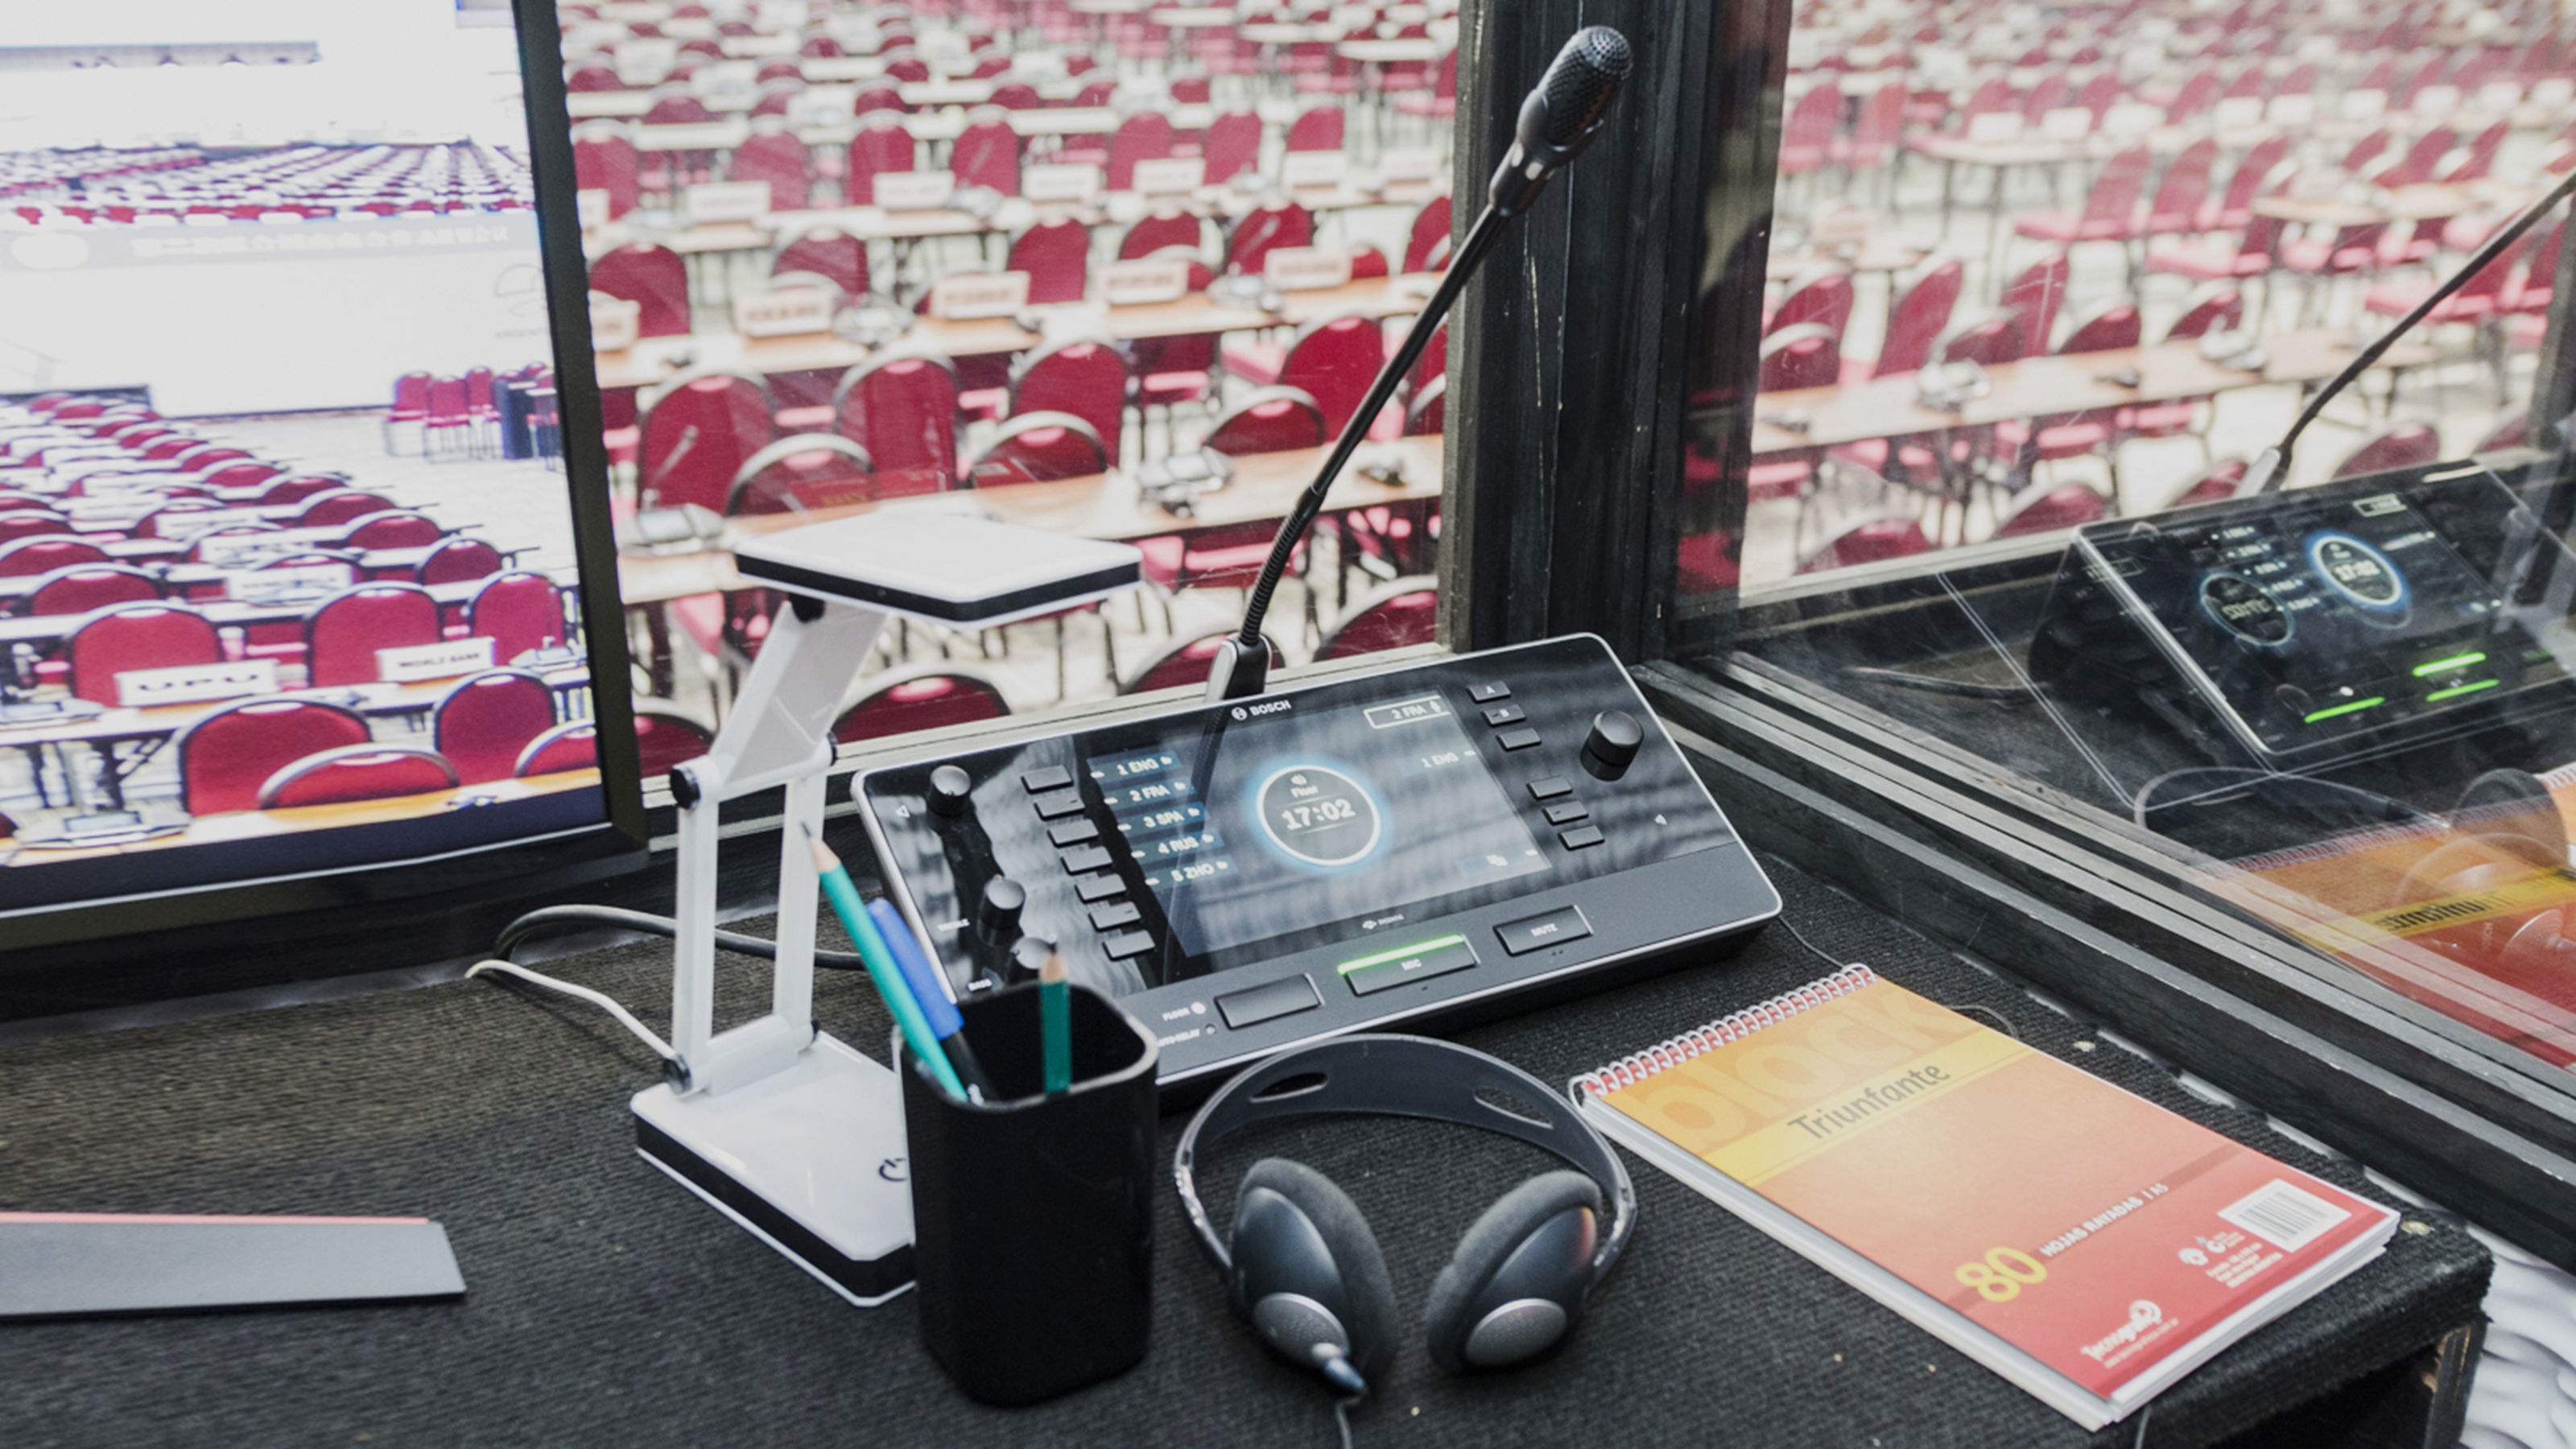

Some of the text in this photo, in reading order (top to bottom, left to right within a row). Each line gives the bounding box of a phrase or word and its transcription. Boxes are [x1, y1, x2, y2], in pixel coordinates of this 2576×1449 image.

[1486, 685, 1496, 695] A
[1249, 700, 1291, 716] BOSCH
[1391, 704, 1428, 720] 2 FRA
[1117, 758, 1159, 775] 1 ENG
[1421, 752, 1459, 769] 1 ENG
[1129, 784, 1170, 802] 2 FRA
[1290, 786, 1319, 798] Floor
[1143, 811, 1185, 828] 3 SPA
[1282, 799, 1356, 830] 17:02
[1158, 836, 1199, 854] 4 RUS
[1171, 863, 1215, 881] 5 ZHO
[1530, 923, 1558, 937] MUTE
[1401, 958, 1422, 971] MIC
[1621, 987, 1979, 1150] block
[1786, 1063, 1951, 1140] Triunfante
[1955, 1246, 2048, 1302] 80
[2039, 1226, 2088, 1257] HOJAS
[2083, 1195, 2144, 1233] RAYADAS
